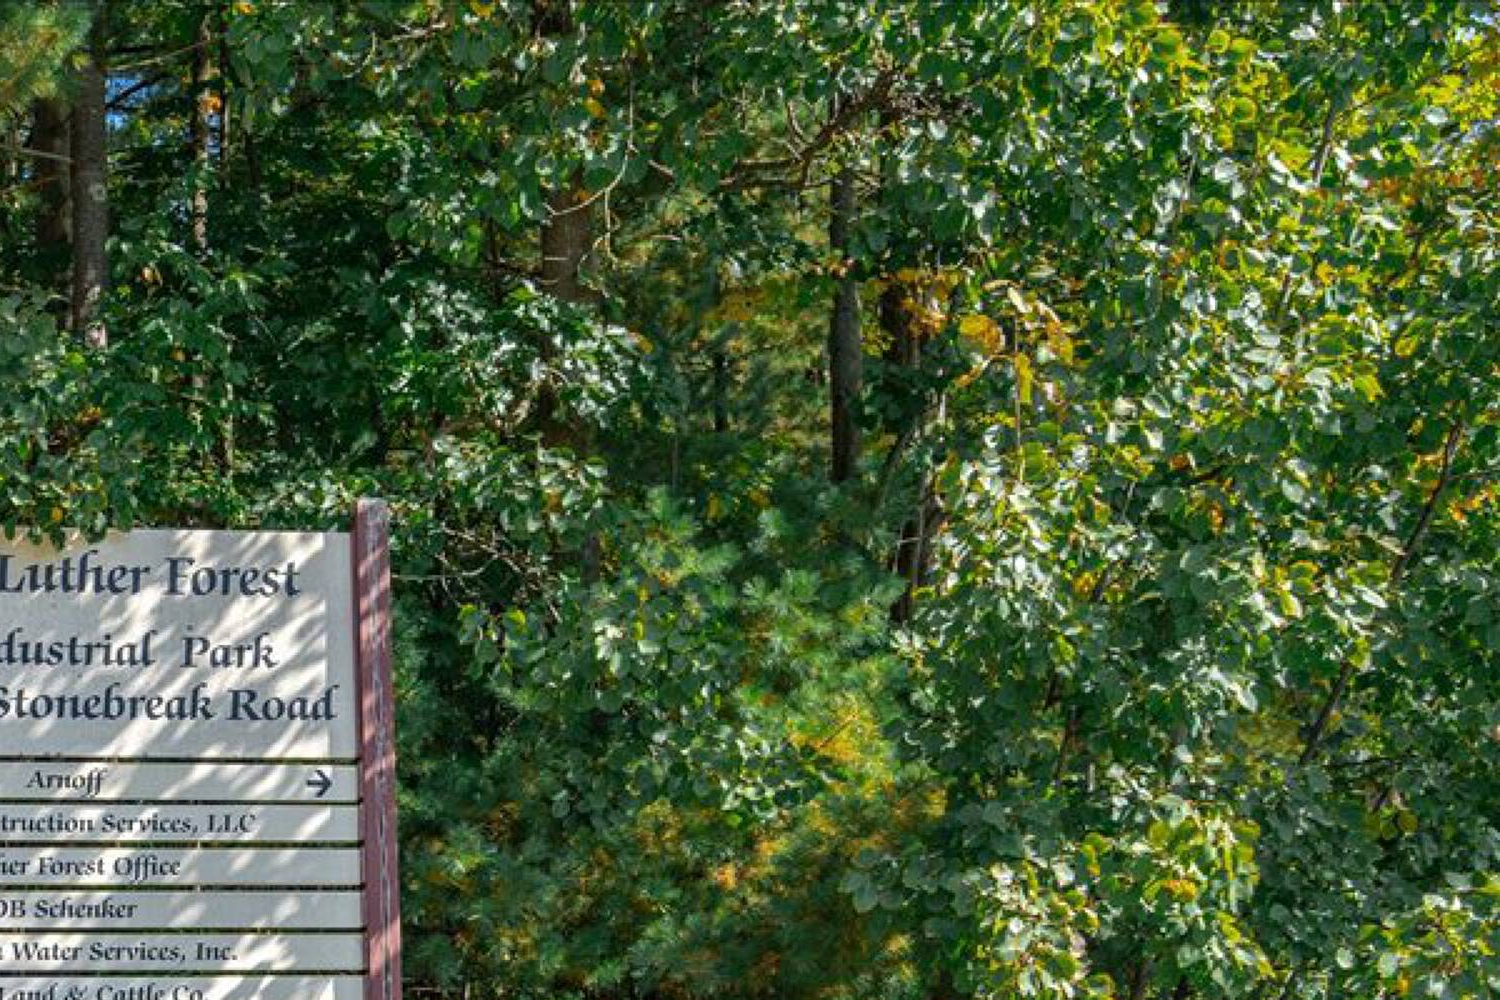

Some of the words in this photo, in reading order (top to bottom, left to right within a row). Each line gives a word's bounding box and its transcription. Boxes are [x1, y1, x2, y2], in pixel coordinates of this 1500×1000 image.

[165, 557, 300, 597] Forest
[180, 633, 278, 669] Park
[225, 686, 339, 721] Road
[26, 767, 108, 797] Arnoff
[101, 812, 199, 835] Services,
[206, 813, 256, 833] LLC
[38, 856, 104, 877] Forest
[113, 855, 181, 883] Office
[33, 898, 138, 919] Schenker
[11, 943, 81, 963] Water
[90, 942, 186, 965] Services,
[195, 943, 238, 961] Inc.
